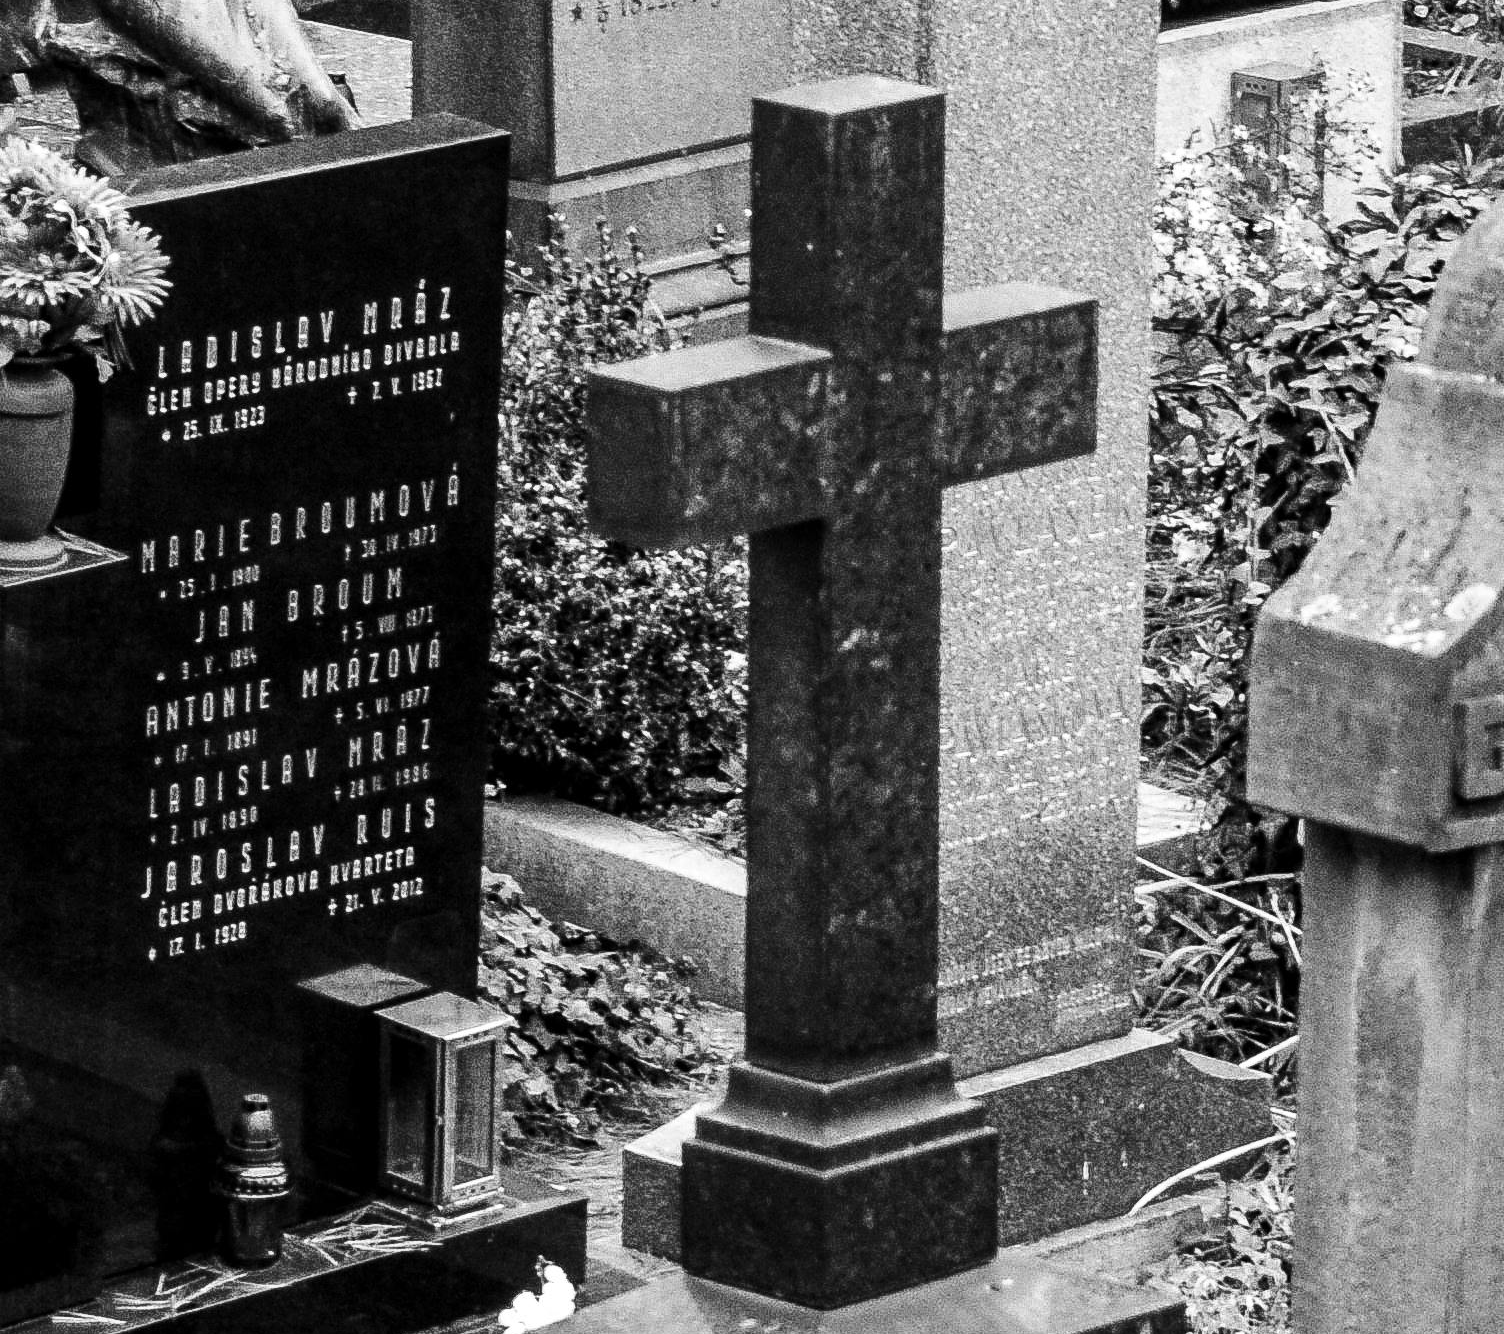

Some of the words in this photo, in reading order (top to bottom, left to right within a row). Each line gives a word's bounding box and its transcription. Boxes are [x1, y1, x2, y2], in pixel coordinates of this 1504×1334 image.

[146, 386, 192, 416] ČLEN
[272, 343, 372, 389] NÁRODNÍHO
[384, 331, 460, 366] DIVADLA
[157, 310, 334, 378] LADISLAV
[363, 277, 451, 335] MRÁZ
[141, 519, 251, 574] MARIE
[271, 461, 460, 547] BROUMOVÁ
[195, 599, 255, 643] JAN
[288, 566, 403, 622] BROUM
[145, 678, 271, 737] ANTONIE
[302, 630, 442, 699] MRÁZOVÁ
[149, 747, 318, 819] LADISLAV
[348, 717, 432, 768] MRÁZ
[141, 823, 325, 899] JAROSLAV
[158, 899, 202, 929] ČLEN
[214, 870, 320, 915] DVOŘÁKOVA
[330, 845, 415, 886] KVARTETA
